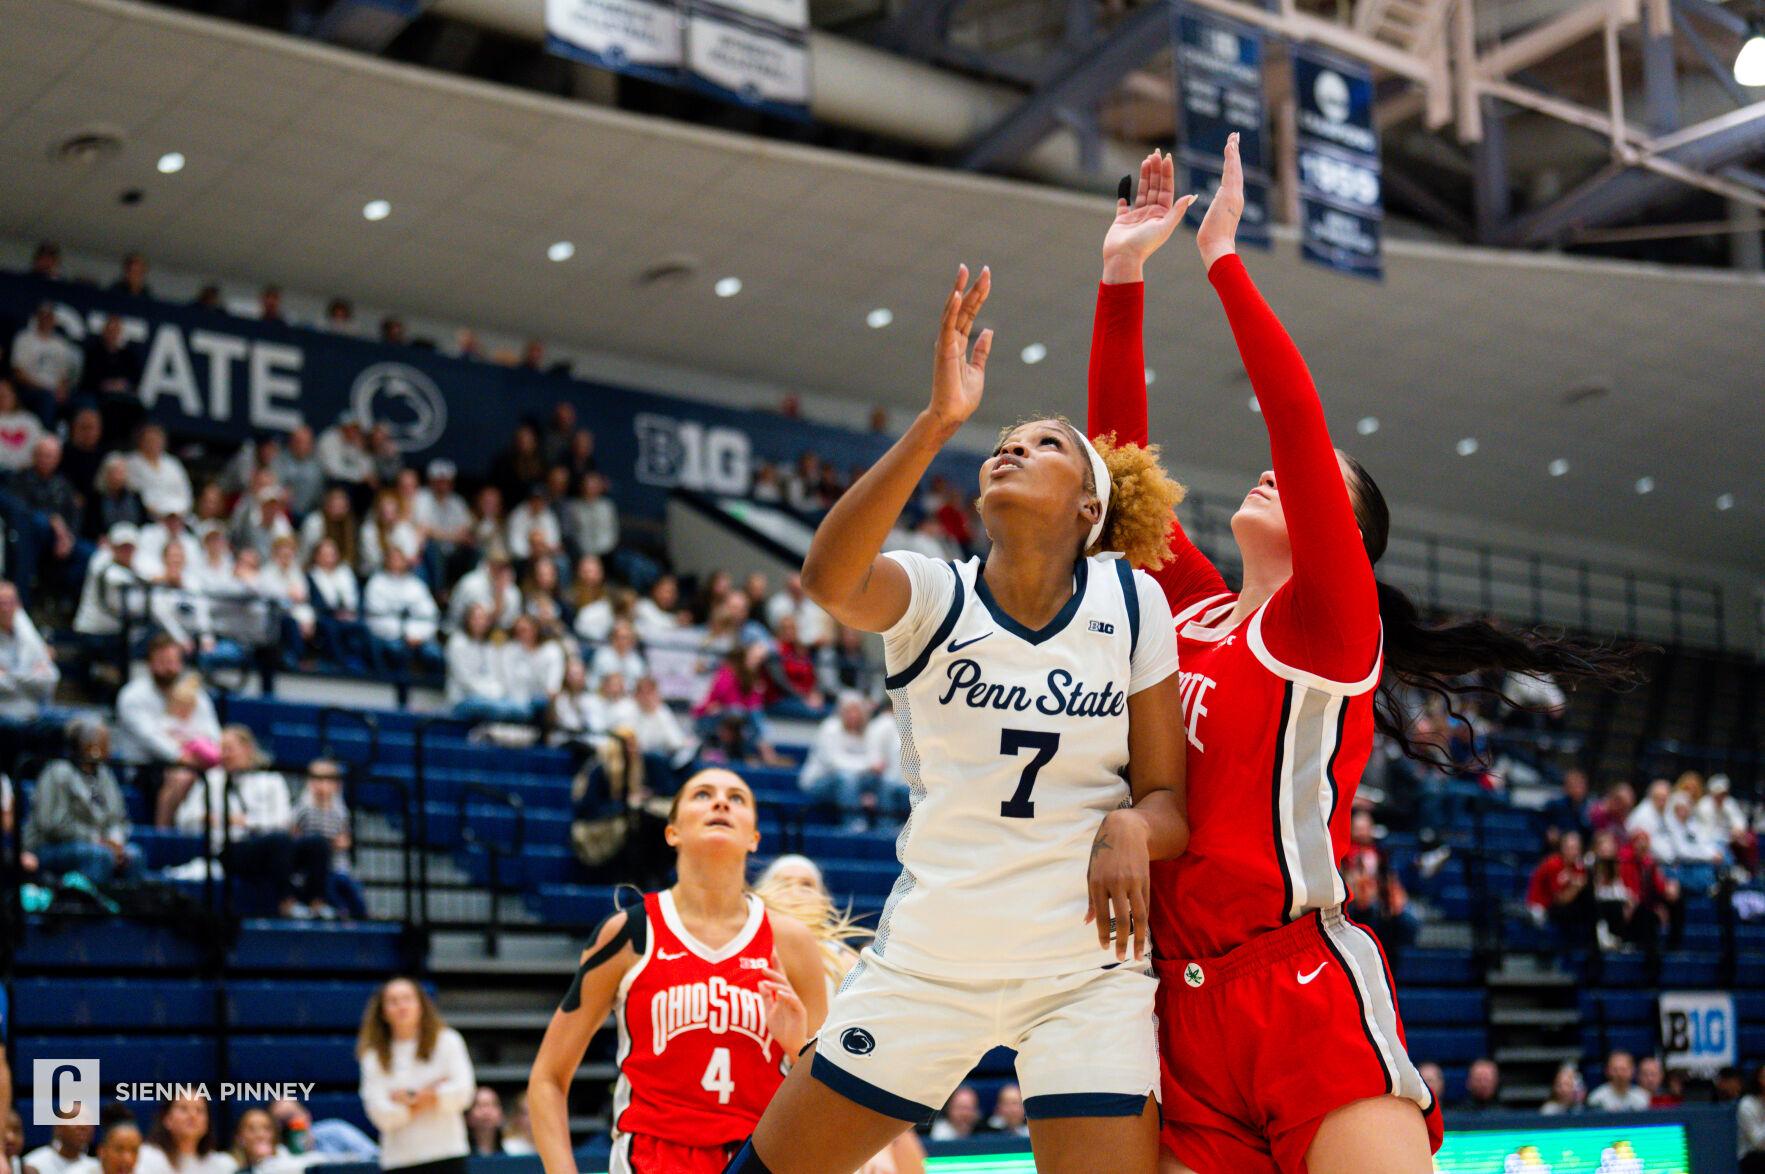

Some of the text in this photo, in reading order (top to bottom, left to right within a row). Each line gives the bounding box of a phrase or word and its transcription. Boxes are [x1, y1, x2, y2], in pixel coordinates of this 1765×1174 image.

[939, 659, 1032, 711] Penn
[1036, 669, 1125, 717] State
[1000, 728, 1061, 818] 7
[701, 1047, 735, 1104] 4
